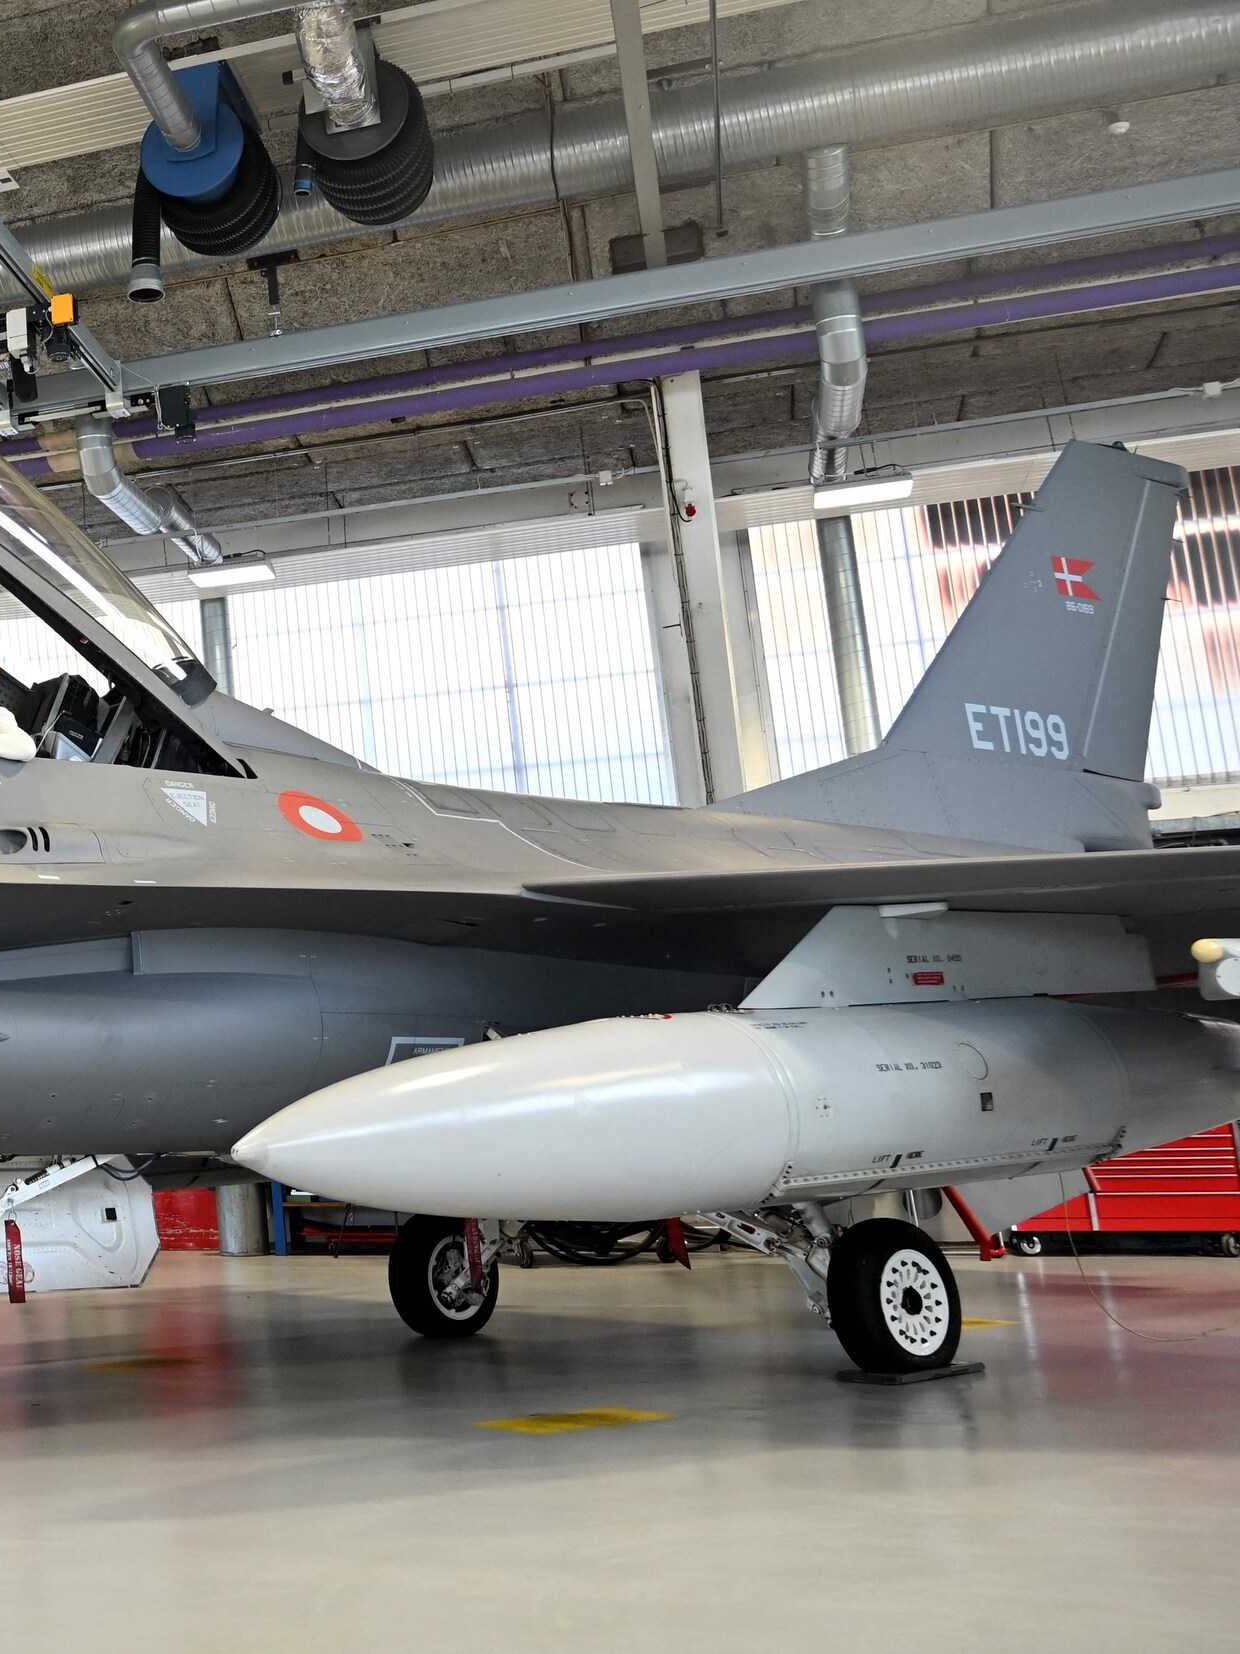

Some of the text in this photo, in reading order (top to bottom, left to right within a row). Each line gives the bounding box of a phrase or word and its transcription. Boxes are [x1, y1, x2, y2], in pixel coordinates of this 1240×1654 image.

[964, 702, 1070, 761] ET199
[876, 1063, 903, 1072] SERIAL
[1031, 1137, 1048, 1146] LIFT
[872, 1154, 891, 1163] LIFT
[14, 1243, 22, 1267] NOSE
